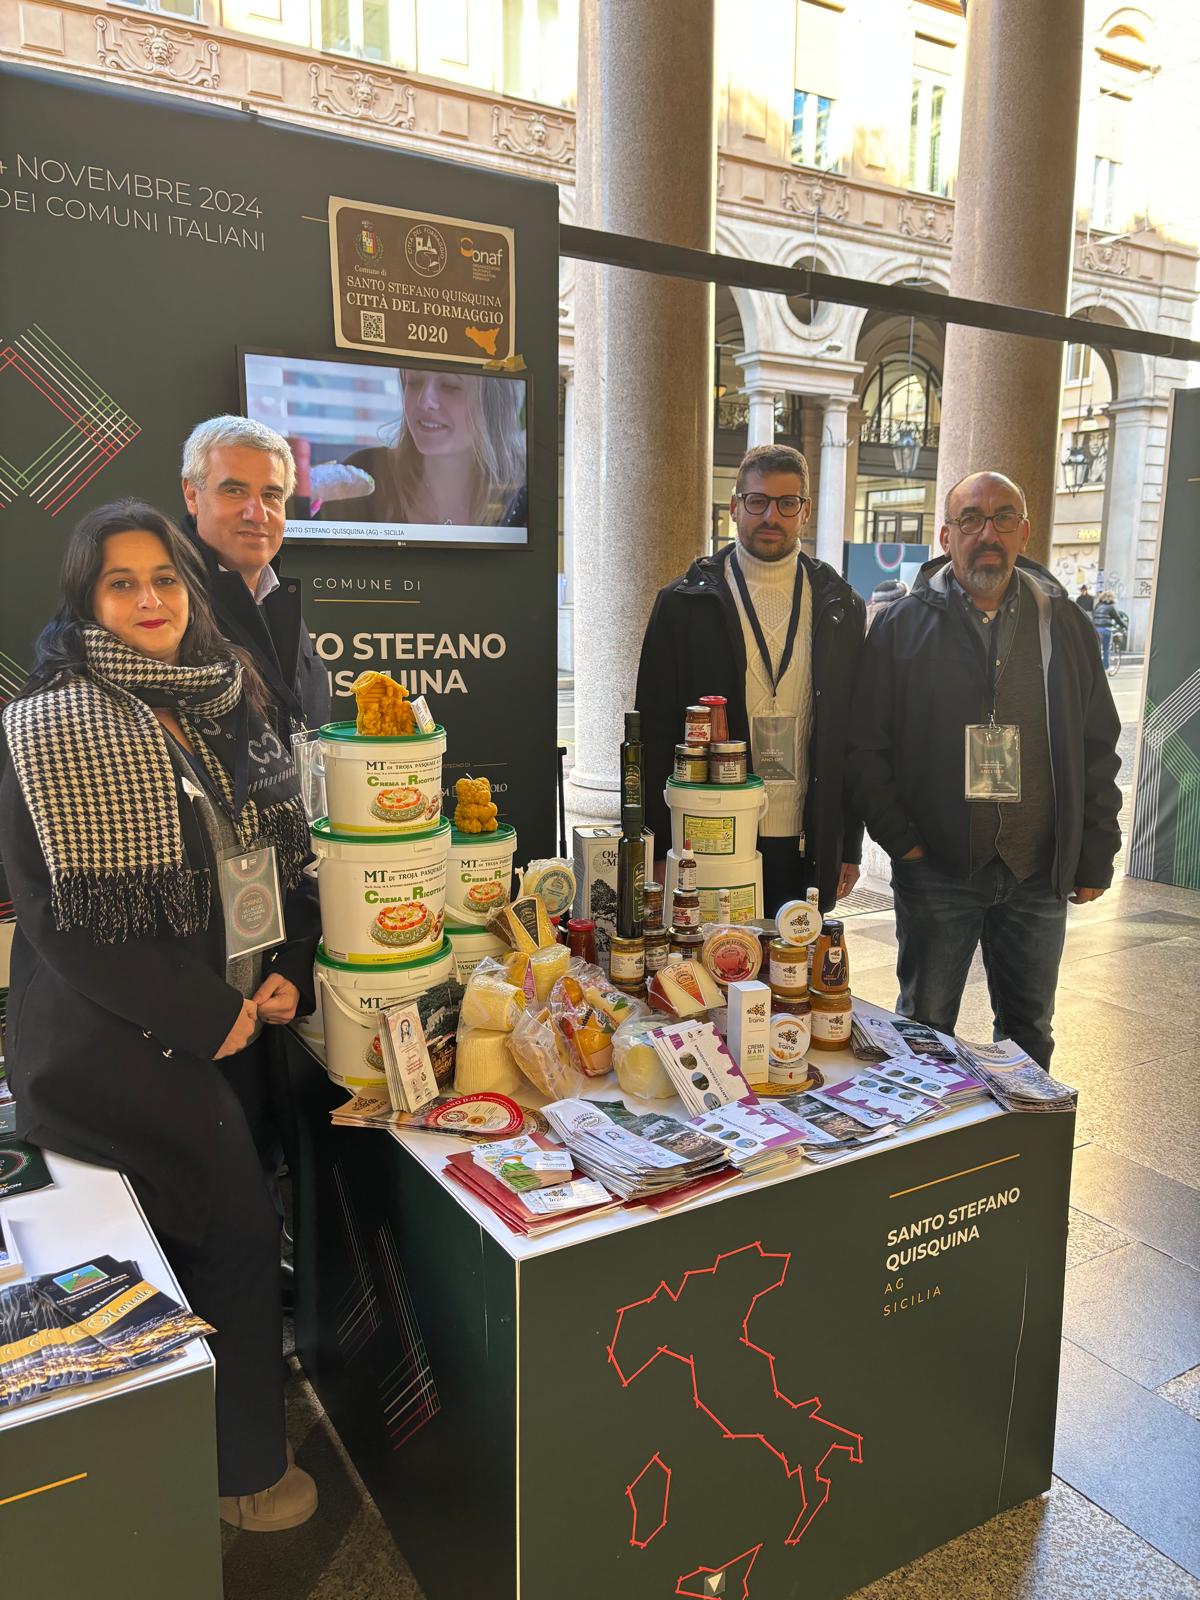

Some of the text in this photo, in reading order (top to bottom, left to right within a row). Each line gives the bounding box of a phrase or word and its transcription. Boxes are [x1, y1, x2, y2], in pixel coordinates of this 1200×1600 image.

[17, 153, 262, 219] NOVEMBRE 2024
[46, 196, 158, 232] COMUNI
[168, 215, 265, 251] ITALIANI
[354, 265, 387, 277] Comune di
[346, 275, 502, 308] SANTO STEFANO QUISQUINA
[346, 292, 504, 325] CITTÀ DEL FORMAGGIO
[408, 323, 449, 344] 2020
[332, 528, 365, 536] QUISQUINA
[366, 528, 379, 536] (AG)
[313, 577, 420, 591] COMUNE DI
[353, 633, 507, 660] STEFANO
[366, 761, 387, 771] MT
[460, 859, 479, 868] MT
[363, 870, 389, 882] MT
[398, 871, 418, 881] TROJA
[360, 997, 383, 1009] MT
[887, 1187, 1021, 1247] SANTO STEFANO
[885, 1225, 980, 1272] QUISQUINA
[884, 1277, 904, 1295] AG
[883, 1285, 942, 1317] SICILIA
